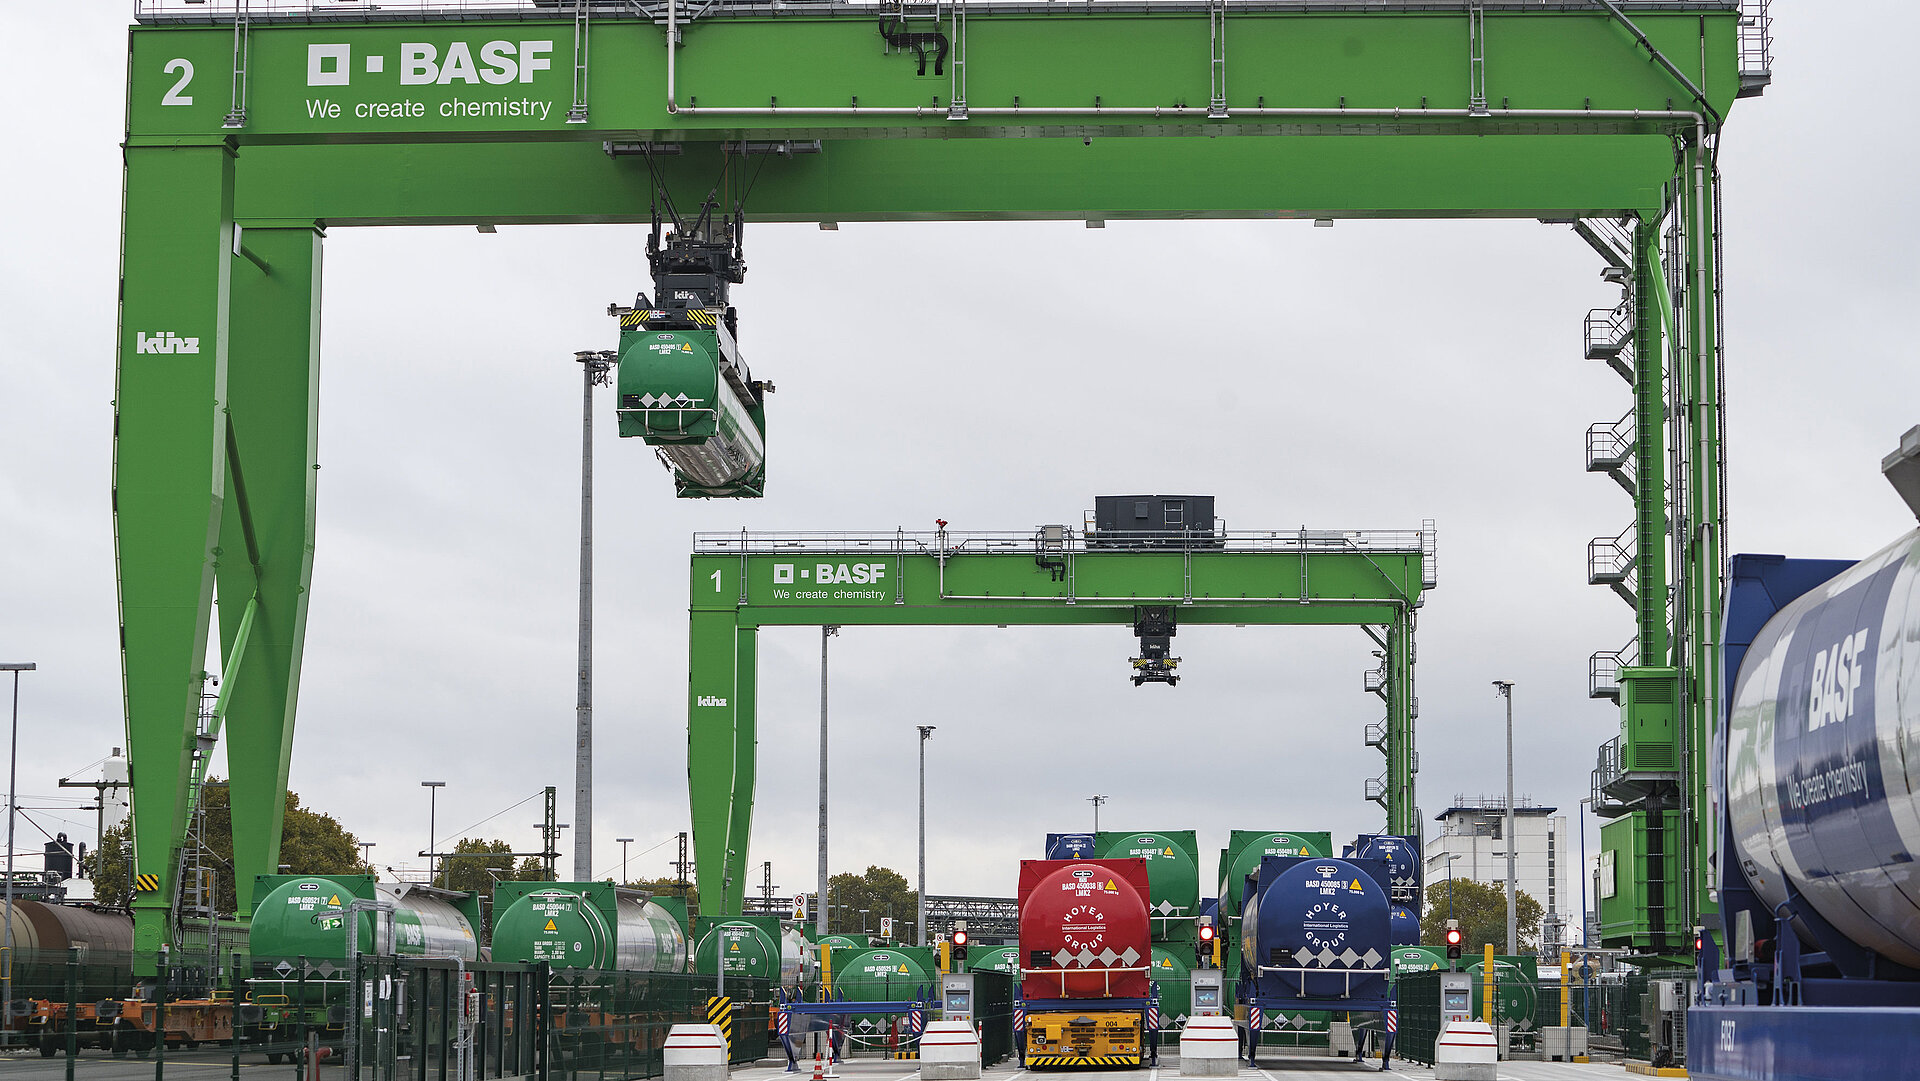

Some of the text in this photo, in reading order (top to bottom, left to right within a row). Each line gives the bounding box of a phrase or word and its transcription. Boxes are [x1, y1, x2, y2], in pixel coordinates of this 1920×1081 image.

[400, 40, 553, 85] BASF
[161, 58, 194, 106] 2
[306, 96, 552, 120] We create chemistry
[136, 331, 200, 354] künz
[710, 569, 722, 593] 1
[816, 563, 886, 584] BASF
[773, 589, 886, 601] We create chemistry
[1808, 627, 1869, 733] BASF
[697, 695, 727, 707] künz
[1786, 755, 1869, 810] We create chemistry
[1306, 880, 1320, 888] BASD
[1320, 880, 1341, 888] 450085
[1320, 887, 1336, 895] LMK2
[288, 896, 301, 904] BASD
[299, 903, 315, 911] LMK2
[1063, 905, 1104, 922] HOYER
[1305, 902, 1347, 920] HOYER
[1064, 933, 1103, 950] GROUP
[1305, 931, 1345, 948] GROUP
